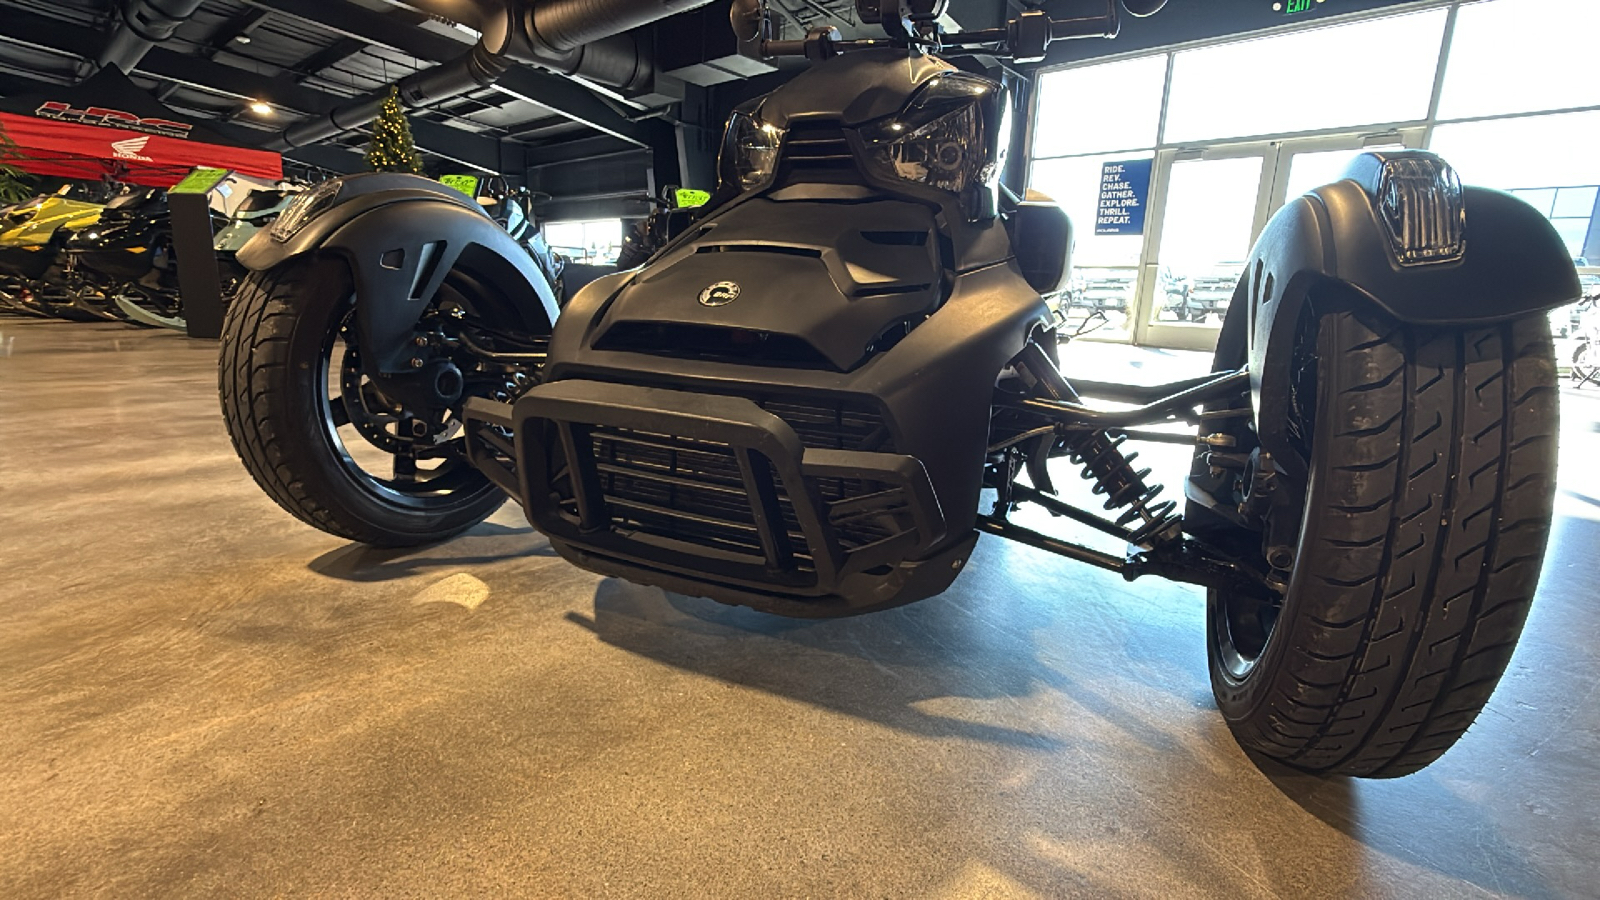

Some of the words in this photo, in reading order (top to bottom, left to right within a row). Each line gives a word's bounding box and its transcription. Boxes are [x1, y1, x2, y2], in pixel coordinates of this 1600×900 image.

[112, 151, 154, 162] HONDA
[1104, 165, 1126, 174] RIDE.
[1103, 174, 1121, 182] REV.
[1102, 181, 1132, 191] CHASE.
[1101, 190, 1136, 199] GATHER.
[1100, 198, 1140, 207] EXPLORE.
[1100, 208, 1130, 216] THRILL.
[1098, 216, 1131, 224] REPEAT.
